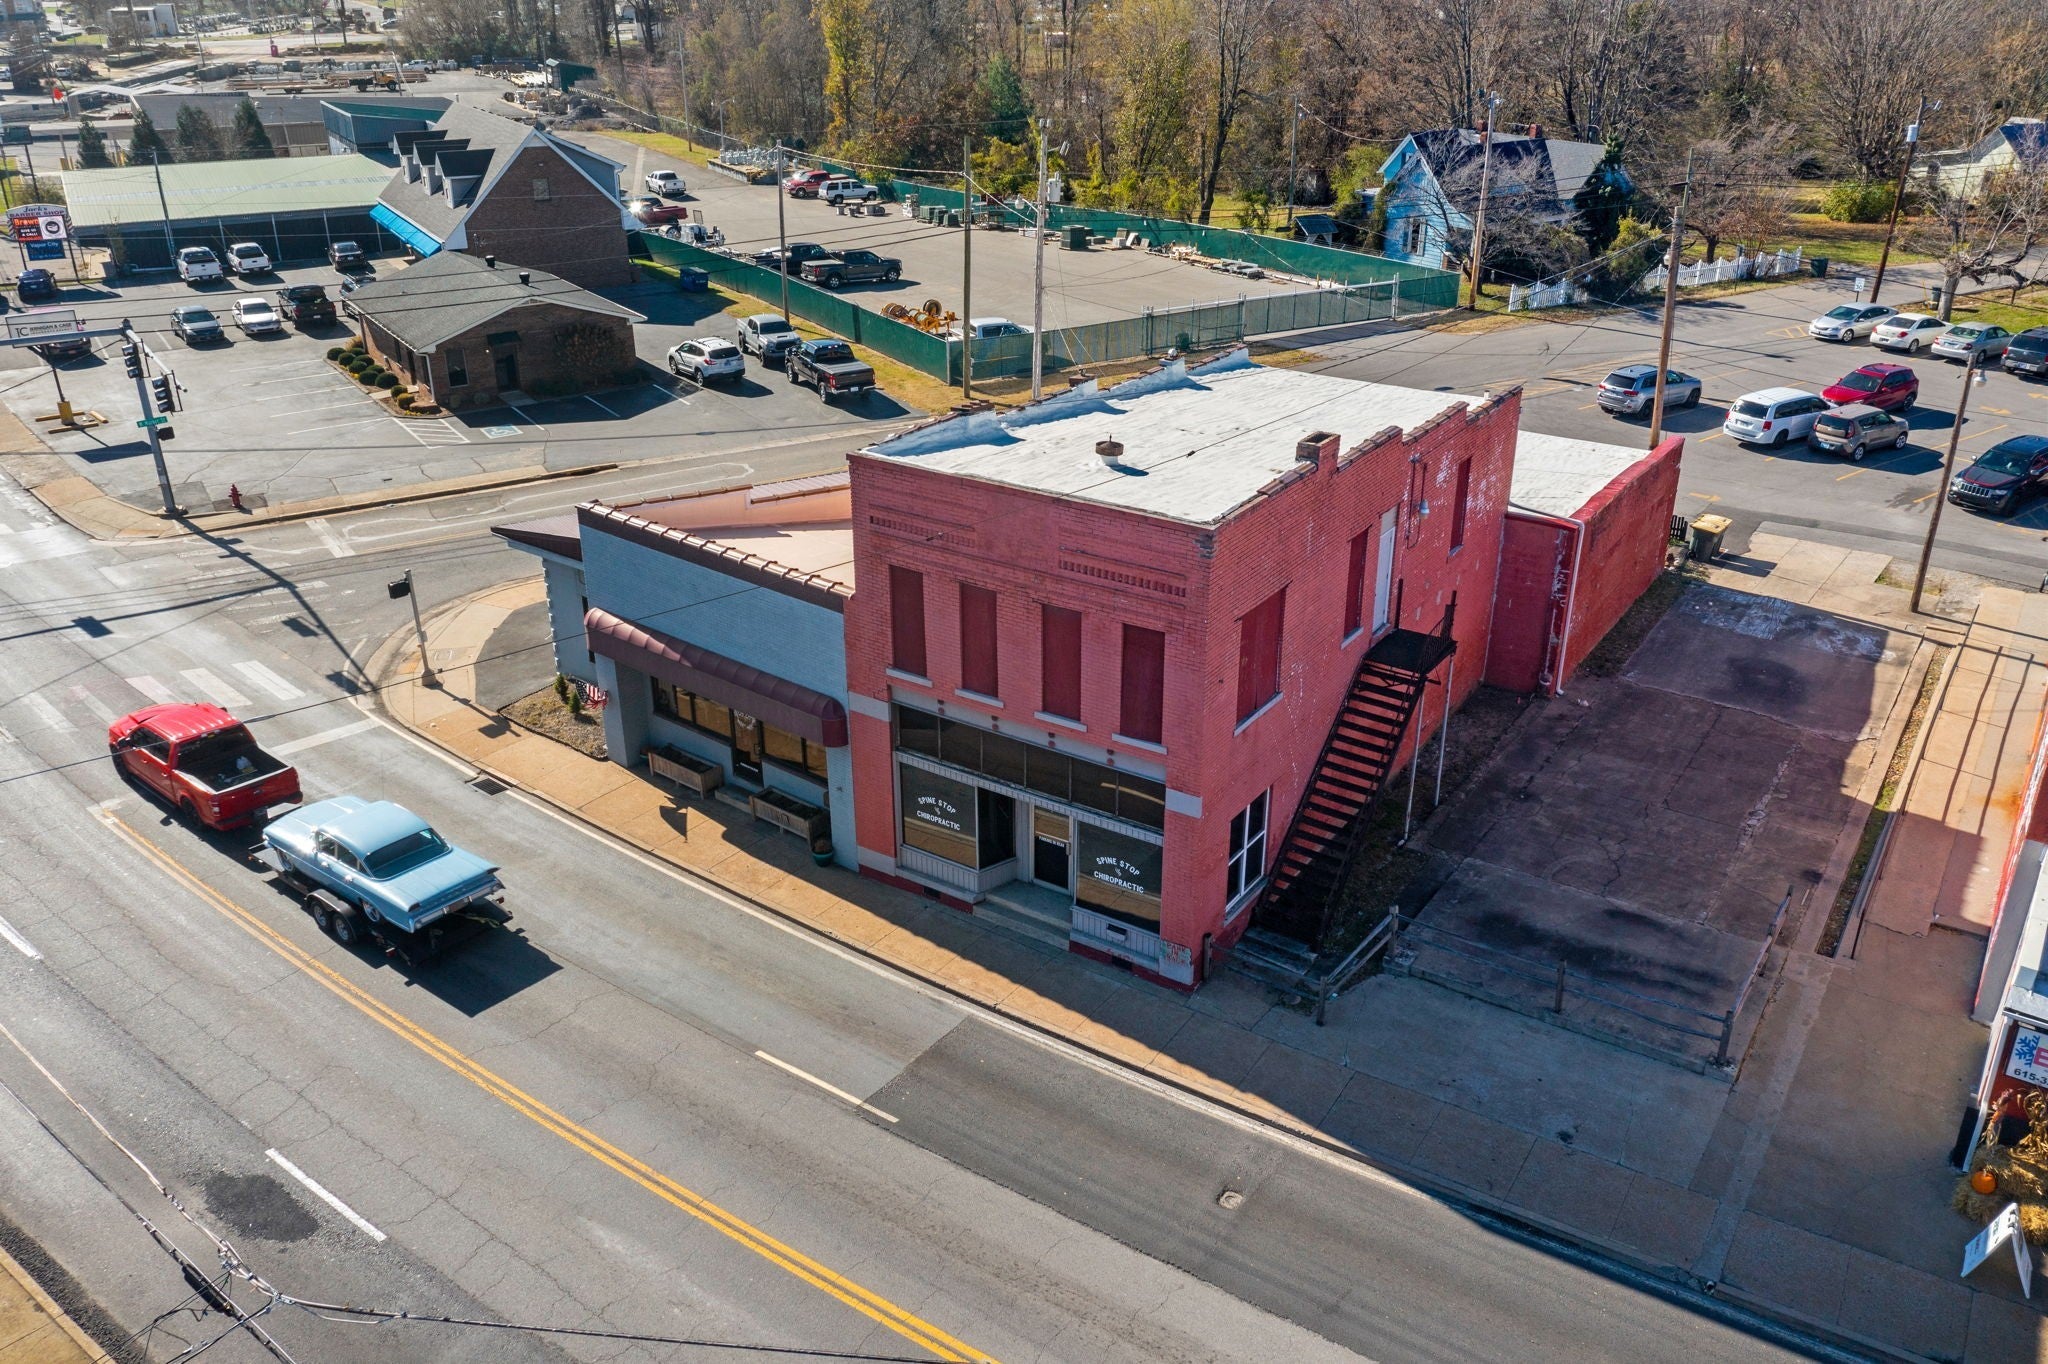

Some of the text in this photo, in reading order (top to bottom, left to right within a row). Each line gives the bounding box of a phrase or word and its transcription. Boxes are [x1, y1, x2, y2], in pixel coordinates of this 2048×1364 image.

[918, 796, 956, 814] SPINE STOP
[916, 810, 961, 831] CHIROPRACTIC
[1096, 856, 1140, 876] SPINE STOP
[1093, 870, 1144, 894] CHIROPRACTIC
